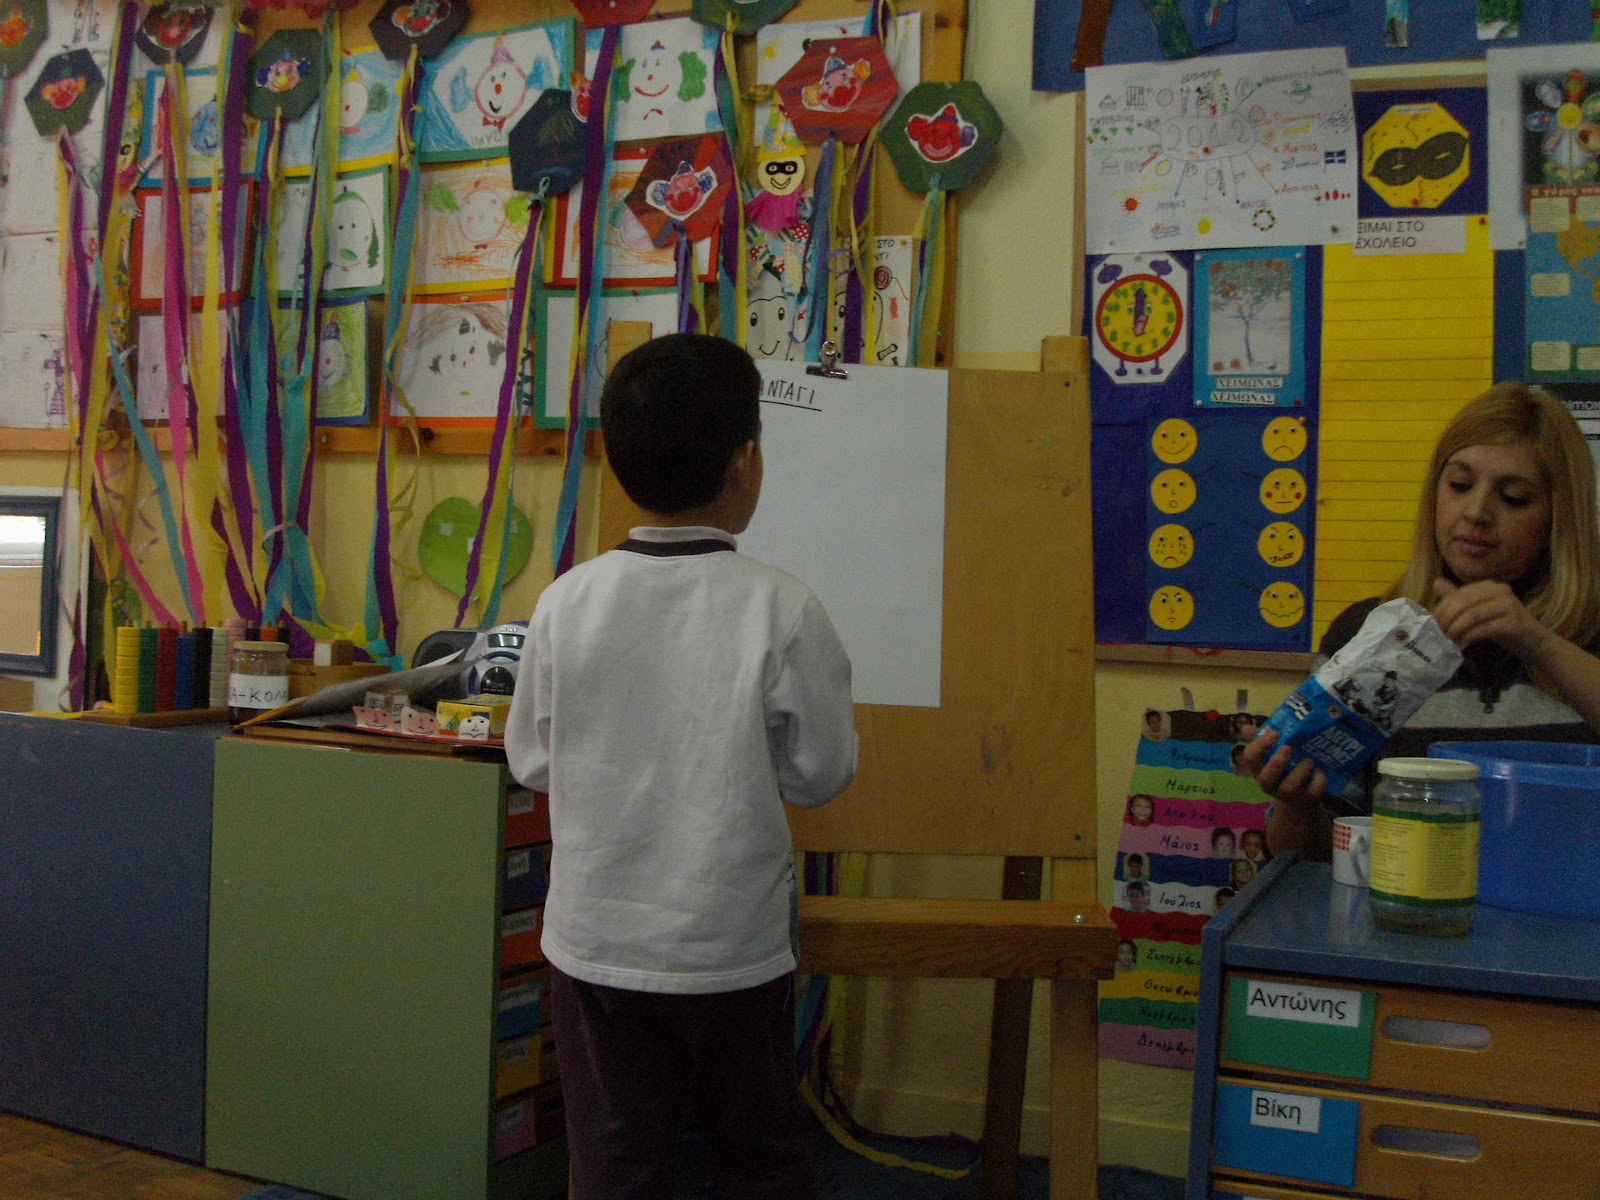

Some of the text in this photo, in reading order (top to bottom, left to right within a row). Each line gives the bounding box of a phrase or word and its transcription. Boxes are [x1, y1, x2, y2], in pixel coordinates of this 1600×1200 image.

[1357, 220, 1424, 234] ΕΙΜΑΙ ΣΤΟ
[1355, 236, 1416, 249] ΣΧΟΛΕΙΟ
[1218, 378, 1281, 388] ΧΕΙΜΩΝΑΣ
[1212, 392, 1274, 403] ΧΕΙΜΩΝΑΣ
[1250, 988, 1347, 1019] Αντώνης
[1255, 1098, 1302, 1124] Βίκη
